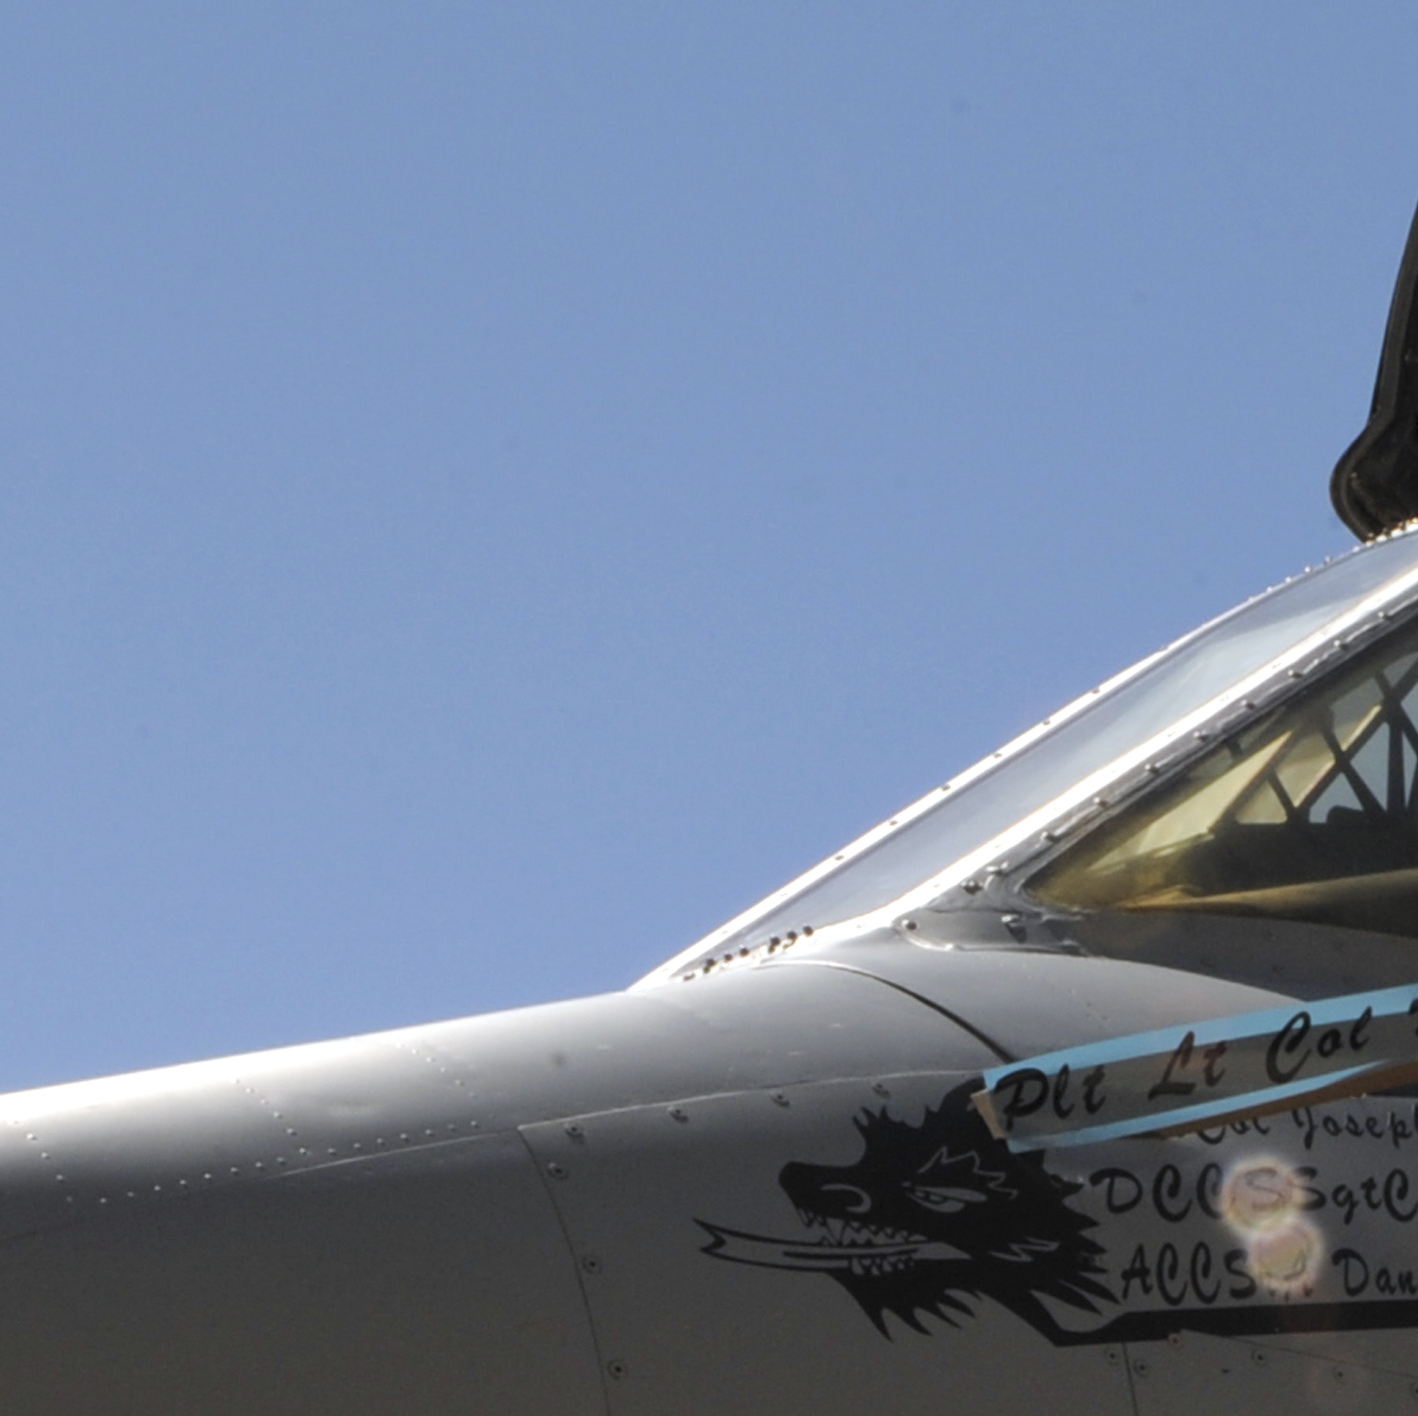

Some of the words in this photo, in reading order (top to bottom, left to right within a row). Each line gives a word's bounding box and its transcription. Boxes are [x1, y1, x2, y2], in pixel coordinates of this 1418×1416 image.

[993, 1064, 1106, 1132] Plt
[1147, 1030, 1228, 1099] Lt
[1265, 1005, 1373, 1084] Col
